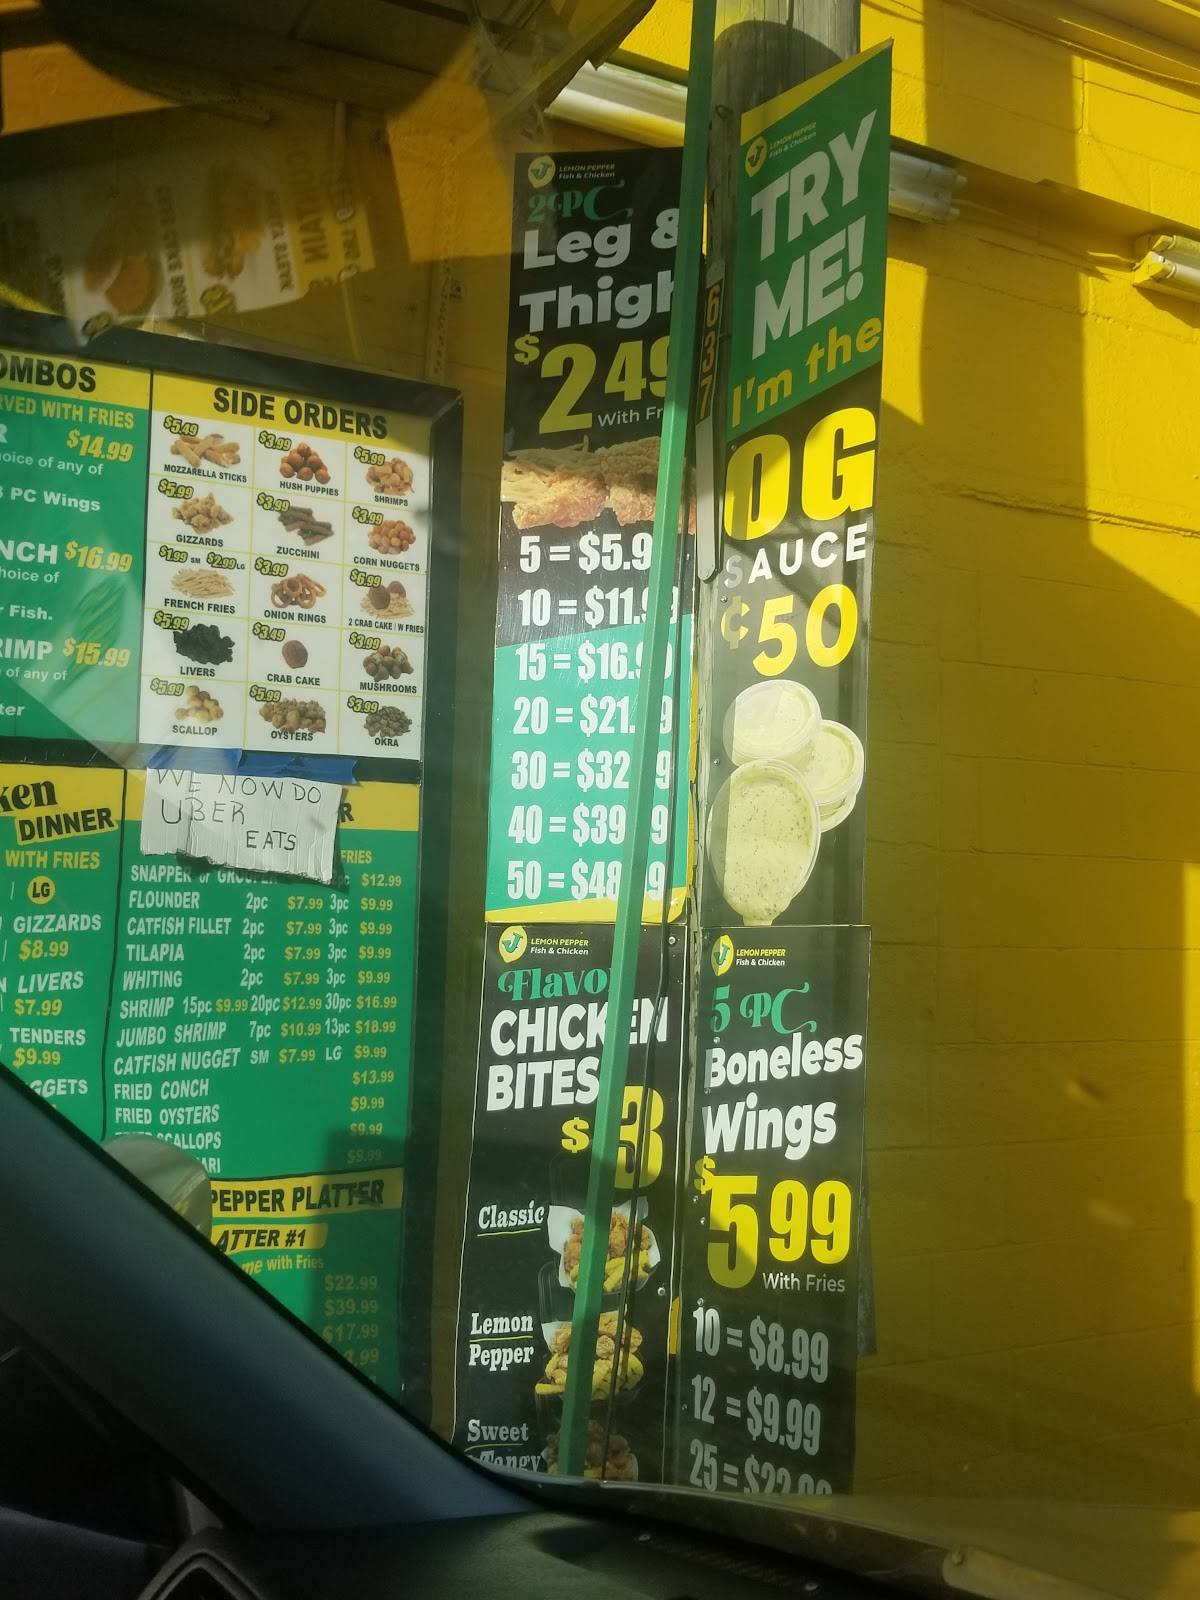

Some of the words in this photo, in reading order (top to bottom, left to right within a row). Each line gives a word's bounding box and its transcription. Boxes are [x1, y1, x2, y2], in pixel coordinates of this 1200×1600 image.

[751, 109, 876, 262] TRY
[523, 223, 631, 270] Leg
[752, 216, 866, 361] ME!
[732, 368, 793, 428] I'm
[805, 317, 882, 384] the
[41, 400, 83, 422] WITH
[88, 407, 135, 430] FRIES
[213, 386, 276, 421] SIDE
[284, 399, 388, 440] ORDERS
[597, 409, 640, 427] With
[164, 415, 198, 437] $5.49
[67, 428, 134, 462] $14.99
[259, 430, 292, 452] $3.99
[354, 446, 385, 466] $5.99
[164, 464, 217, 479] MOZZARELLA
[219, 471, 247, 483] STICKS
[724, 407, 876, 541] OG
[10, 487, 37, 502] PC
[43, 491, 101, 512] Wings
[158, 479, 194, 500] $5.99
[279, 481, 303, 491] HUSH
[305, 484, 339, 497] PUPPIES
[257, 492, 290, 512] $3.99
[374, 495, 408, 507] SHRIMPS
[352, 506, 383, 526] $3.99
[176, 534, 224, 548] GIZZARDS
[64, 540, 133, 573] $16.99
[159, 544, 188, 564] $1.99
[206, 552, 237, 570] $2.99
[276, 546, 320, 559] ZUCCHINI
[520, 535, 540, 573] 5
[724, 523, 868, 589] SAUCE
[254, 557, 288, 577] $3.99
[353, 556, 378, 567] CORN
[381, 558, 420, 572] NUGGETS
[350, 570, 382, 588] $6.99
[10, 605, 53, 620] Fish.
[164, 598, 204, 612] FRENCH
[207, 601, 235, 614] FRIES
[264, 609, 295, 621] ONION
[297, 612, 326, 624] RINGS
[517, 588, 551, 626] 10
[154, 610, 190, 632] $5.99
[252, 622, 286, 642] $3.49
[349, 632, 381, 650] $3.99
[63, 637, 131, 668] $15.99
[515, 642, 547, 681] 15
[180, 665, 215, 678] LIVERS
[267, 673, 294, 685] CRAB
[296, 675, 320, 686] CAKE
[250, 685, 281, 703] $5.99
[359, 682, 417, 694] MUSHROOMS
[348, 696, 378, 714] $3.99
[513, 695, 549, 735] 20
[172, 724, 218, 736] SCALLOP
[271, 730, 314, 741] OYSTERS
[374, 737, 399, 747] OKRA
[511, 750, 547, 789] 30
[217, 771, 284, 800] NOW
[291, 782, 322, 804] DO
[161, 797, 246, 825] UBER
[18, 807, 115, 842] DINNER
[508, 804, 543, 845] 40
[246, 830, 297, 850] EATS
[5, 850, 47, 869] WITH
[53, 851, 100, 870] FRIES
[131, 865, 192, 884] SNAPPER
[361, 873, 402, 887] $12.99
[507, 860, 542, 899] 50
[32, 882, 50, 898] LG
[129, 890, 200, 909] FLOUNDER
[245, 892, 268, 912] 2pc
[287, 896, 323, 911] $7.99
[330, 893, 350, 913] 3pc
[360, 898, 393, 912] $9.99
[13, 914, 102, 934] GIZZARDS
[127, 916, 185, 936] CATFISH
[188, 917, 232, 935] FILLET
[242, 918, 264, 938] 2pc
[286, 922, 322, 936] $7.99
[328, 918, 349, 938] 3pc
[360, 922, 393, 936] $9.99
[19, 939, 69, 961] $8.99
[126, 943, 185, 962] TILAPIA
[243, 944, 265, 963] 2pc
[284, 946, 321, 961] $7.99
[327, 942, 347, 961] 3pc
[358, 945, 392, 960] $9.99
[530, 946, 547, 955] Fish
[557, 946, 589, 956] Chicken
[531, 938, 559, 946] LEMON
[560, 938, 589, 947] PEPPER
[736, 949, 760, 957] LEMON
[760, 949, 786, 957] PEPPER
[736, 958, 749, 966] Fish
[758, 958, 786, 967] Chicken
[18, 971, 84, 993] LIVERS
[123, 970, 183, 991] WHITING
[240, 968, 263, 988] 2pc
[283, 972, 320, 986] $7.99
[326, 967, 346, 987] 3pc
[357, 971, 391, 985] $9.99
[15, 999, 62, 1016] $7.99
[120, 996, 174, 1019] SHRIMP
[182, 996, 212, 1017] 15pc
[215, 999, 248, 1013] $9.99
[251, 994, 281, 1016] 20pc
[282, 996, 322, 1011] $12.99
[325, 992, 351, 1011] 30pc
[356, 995, 397, 1010] $16.99
[711, 984, 731, 1033] 5
[9, 1028, 86, 1046] TENDERS
[117, 1026, 166, 1048] JUMBO
[174, 1021, 227, 1043] SHRIMP
[249, 1020, 271, 1041] 7pc
[280, 1022, 321, 1037] $10.99
[324, 1018, 350, 1038] 13pc
[355, 1019, 396, 1034] $18.99
[13, 1048, 61, 1068] $9.99
[113, 1053, 176, 1076] CATFISH
[180, 1048, 241, 1071] NUGGET
[250, 1049, 269, 1064] SM
[279, 1049, 316, 1063] $7.99
[325, 1046, 343, 1061] LG
[354, 1045, 387, 1059] $9.99
[704, 1032, 863, 1088] Boneless
[114, 1083, 152, 1101] FRIED
[160, 1079, 210, 1100] CONCH
[352, 1070, 395, 1088] $13.99
[486, 1056, 600, 1111] BITES
[115, 1107, 152, 1125] FRIED
[159, 1104, 221, 1126] OYSTERS
[350, 1096, 385, 1112] $9.99
[702, 1091, 837, 1161] Wings
[210, 1188, 285, 1213] PEPPER
[292, 1179, 385, 1211] PLATTER
[478, 1200, 545, 1229] Classic
[763, 1272, 800, 1291] With
[805, 1273, 846, 1292] Fries
[470, 1312, 533, 1335] Lemon
[692, 1306, 721, 1357] 10
[749, 1315, 829, 1384] $8.99
[469, 1344, 534, 1372] Pepper
[692, 1374, 715, 1424] 12
[747, 1385, 821, 1456] $9.99
[467, 1419, 529, 1443] Sweet
[690, 1438, 718, 1492] 25
